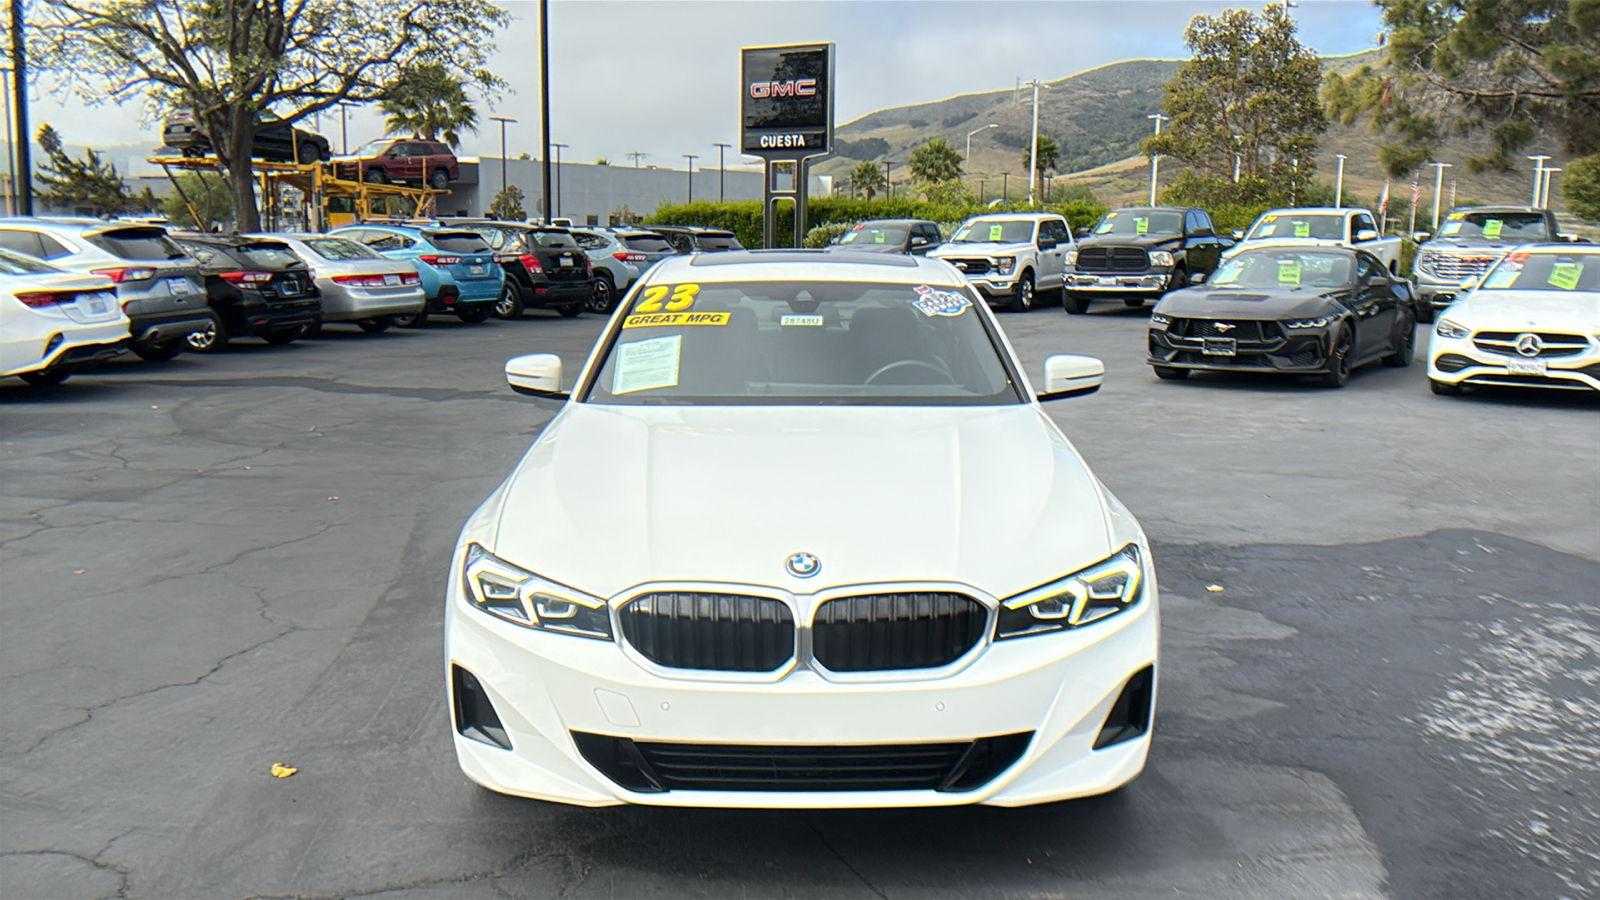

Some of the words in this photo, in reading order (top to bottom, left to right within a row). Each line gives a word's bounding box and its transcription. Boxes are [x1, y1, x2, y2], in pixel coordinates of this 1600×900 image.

[750, 79, 816, 97] GMC
[760, 134, 805, 147] CUESTA
[636, 284, 700, 312] 23
[629, 315, 682, 325] GREAT
[687, 315, 723, 324] MPG
